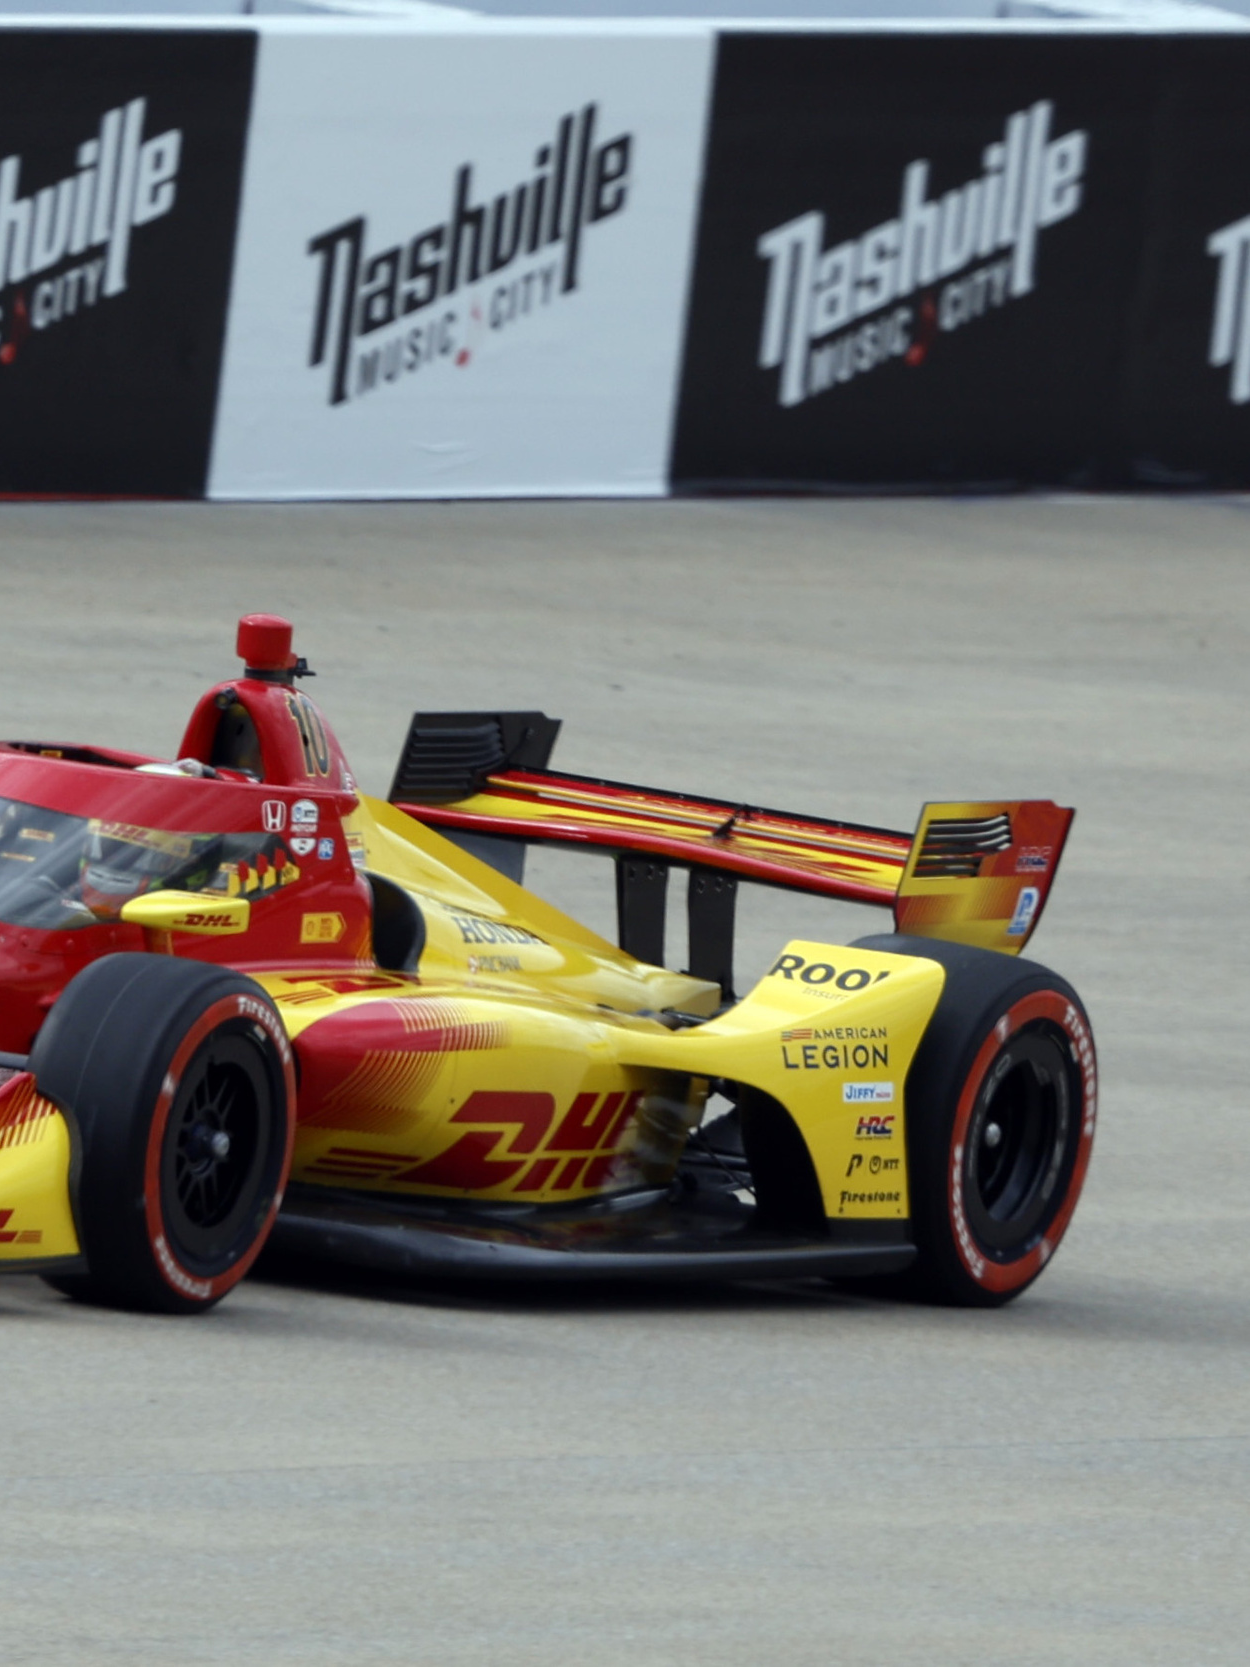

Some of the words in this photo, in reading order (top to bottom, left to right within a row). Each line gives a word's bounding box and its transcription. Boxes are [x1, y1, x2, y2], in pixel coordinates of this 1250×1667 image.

[32, 258, 104, 330] CITY
[356, 312, 459, 396] MUSIC
[486, 263, 558, 333] CITY
[807, 309, 911, 394] MUSIC
[937, 262, 1013, 332] CITY
[283, 691, 331, 778] 10
[184, 913, 234, 927] DHL
[452, 916, 550, 945] HOND
[813, 1027, 888, 1040] AMERICAN
[781, 1044, 889, 1069] LEGION
[846, 1085, 876, 1100] JIFFY
[856, 1116, 895, 1135] HRC
[840, 1191, 900, 1206] Firestone
